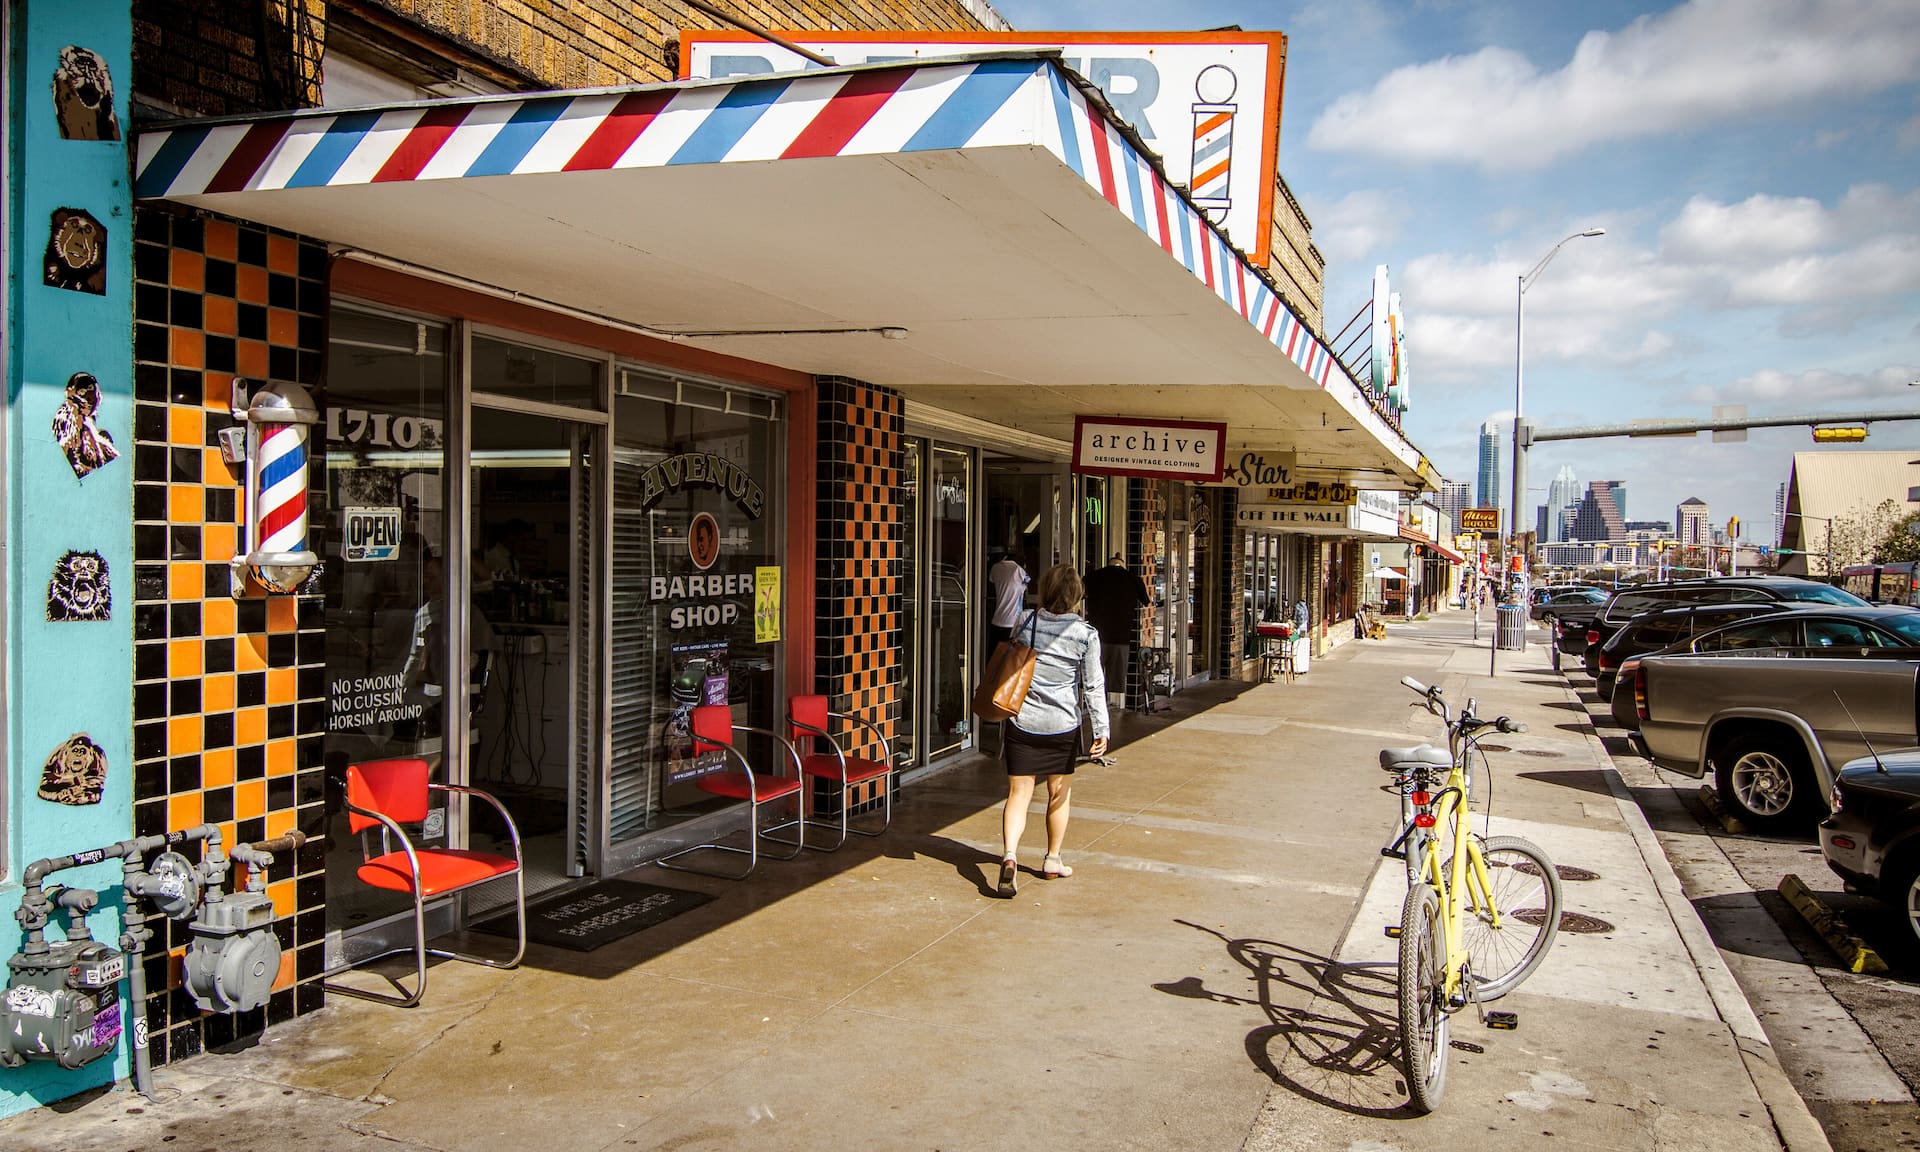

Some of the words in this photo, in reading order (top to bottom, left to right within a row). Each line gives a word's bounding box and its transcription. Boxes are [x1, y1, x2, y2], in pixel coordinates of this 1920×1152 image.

[326, 408, 422, 449] 1710
[1092, 431, 1206, 454] archive
[1094, 455, 1129, 463] DESIGNER
[1132, 458, 1161, 466] VINTAGE
[1164, 460, 1200, 468] CLOTHING
[1238, 452, 1292, 486] Star
[641, 453, 765, 518] AVENUE
[1239, 510, 1266, 521] OFF
[1272, 511, 1300, 521] THE
[1304, 511, 1344, 523] WALL
[350, 515, 397, 547] OPEN
[650, 573, 754, 601] BARBER
[670, 603, 738, 630] SHOP
[332, 678, 351, 695] NO
[332, 696, 351, 713] NO
[354, 687, 407, 710] CUSSIN'
[329, 708, 378, 731] HORSIN'
[378, 704, 423, 723] AROUND
